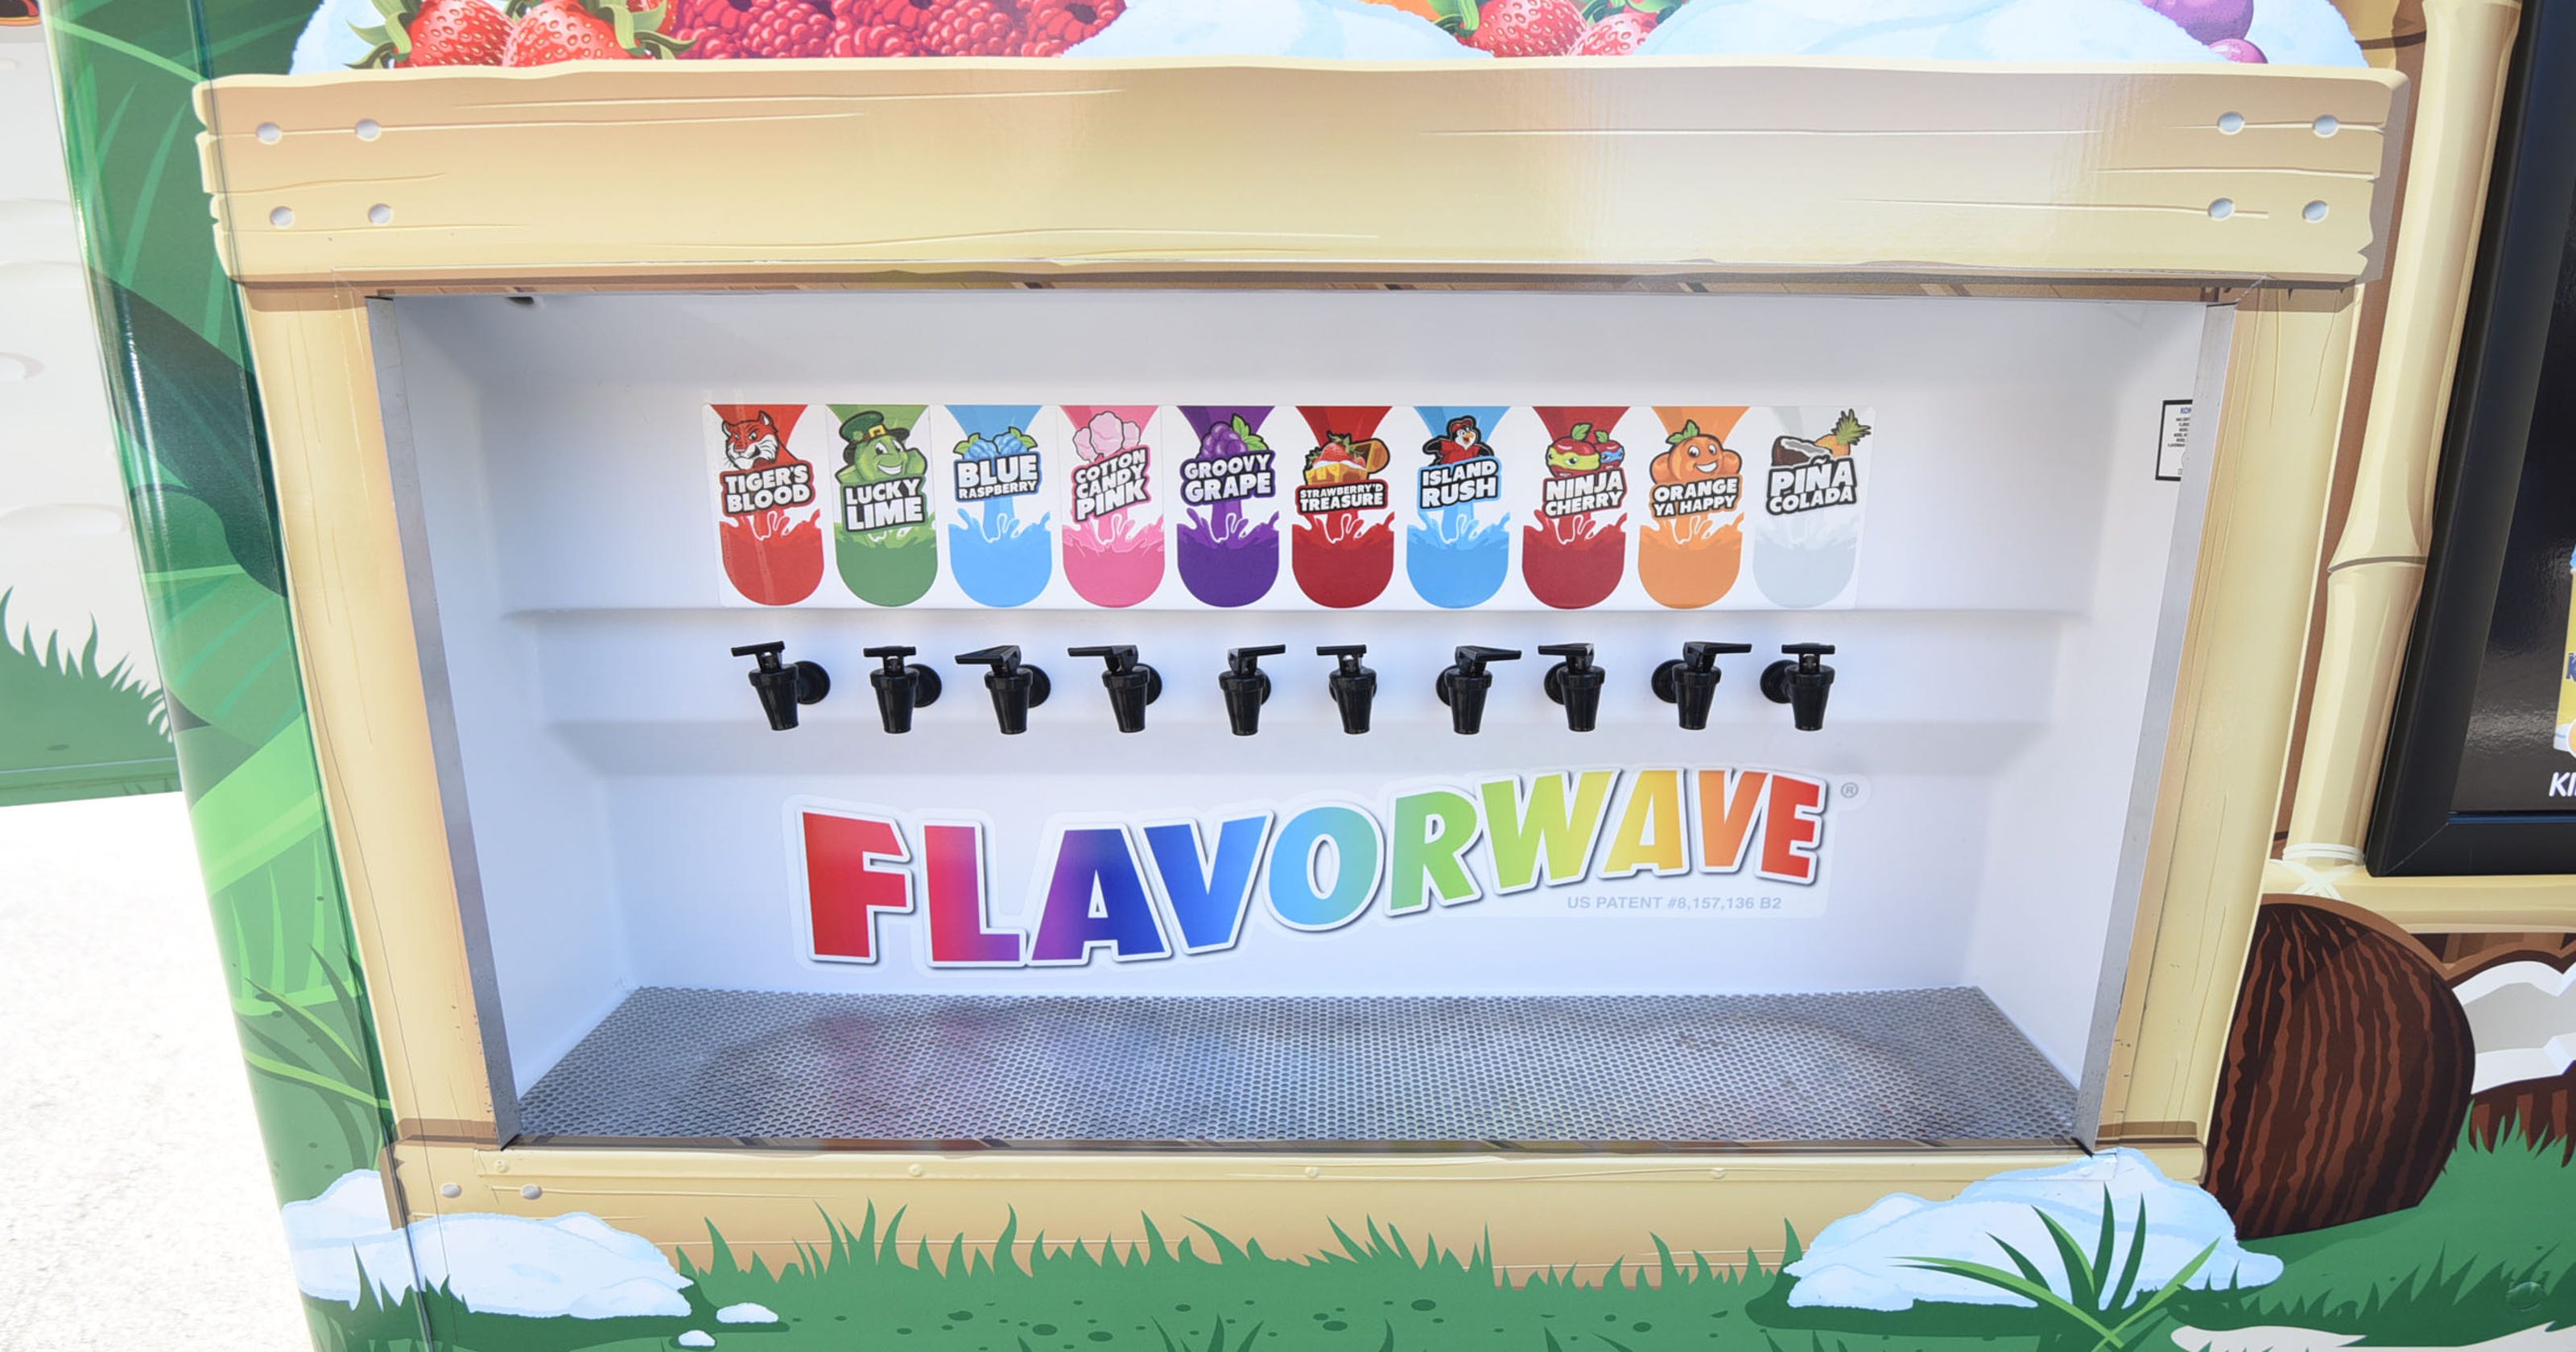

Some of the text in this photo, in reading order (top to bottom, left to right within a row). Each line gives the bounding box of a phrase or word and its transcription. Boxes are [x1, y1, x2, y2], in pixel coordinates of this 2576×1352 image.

[724, 464, 809, 493] TIGER'S
[956, 455, 1039, 486] BLUE
[1074, 448, 1147, 484] COTTON
[1183, 454, 1272, 480] GROOVY
[1422, 460, 1498, 487] ISLAND
[1771, 457, 1854, 496] PIÑA
[844, 479, 921, 505] LUCKY
[958, 480, 1038, 500] RASPBERRY
[1075, 464, 1146, 501] CANDY
[1184, 472, 1272, 503] GRAPE
[1299, 484, 1384, 499] STRAWBERRY'D
[1421, 477, 1497, 508] RUSH
[1546, 472, 1624, 501] NINJA
[1653, 477, 1738, 501] ORANGE
[727, 486, 810, 513] BLOOD
[1075, 480, 1148, 521] PINK
[1299, 493, 1385, 512] TREASURE
[1544, 491, 1624, 517] CHERRY
[1653, 494, 1737, 517] YA HAPPY
[1769, 488, 1853, 513] COLADA
[846, 497, 925, 530] LIME
[799, 767, 1826, 965] FLAVORWAVE
[1567, 896, 1782, 912] US PATENT #8,157,136 B2
